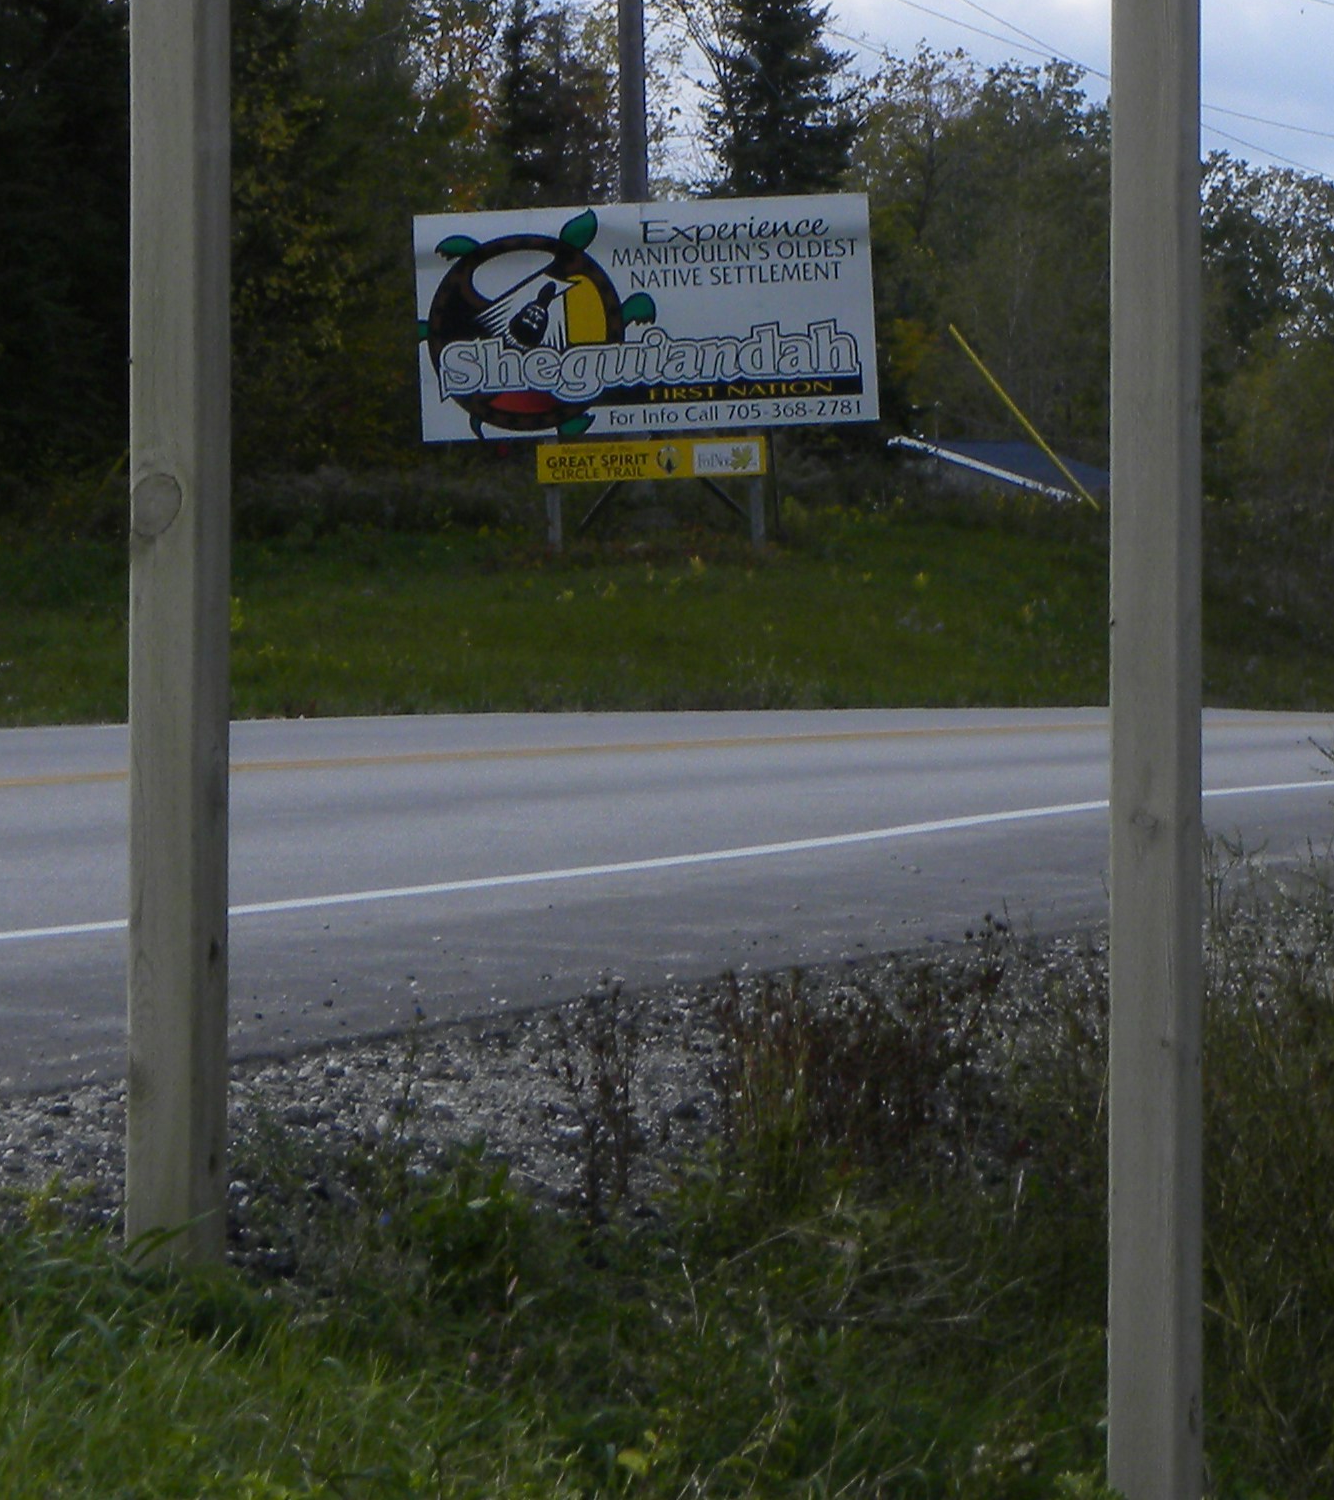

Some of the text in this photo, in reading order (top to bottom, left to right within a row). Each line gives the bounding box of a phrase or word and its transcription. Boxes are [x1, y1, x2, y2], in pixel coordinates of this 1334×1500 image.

[639, 216, 829, 247] Experience
[611, 238, 859, 268] MANITOULIN'S OLDEST
[630, 261, 842, 289] NATIVE SETTLEMENT
[439, 318, 861, 401] Sheguiandah
[648, 380, 834, 401] FIRST NATION
[609, 402, 863, 426] For Info Call 705-368-2781
[546, 452, 649, 469] GREAT SPIRIT
[552, 465, 645, 481] CIRCLE TRAIL
